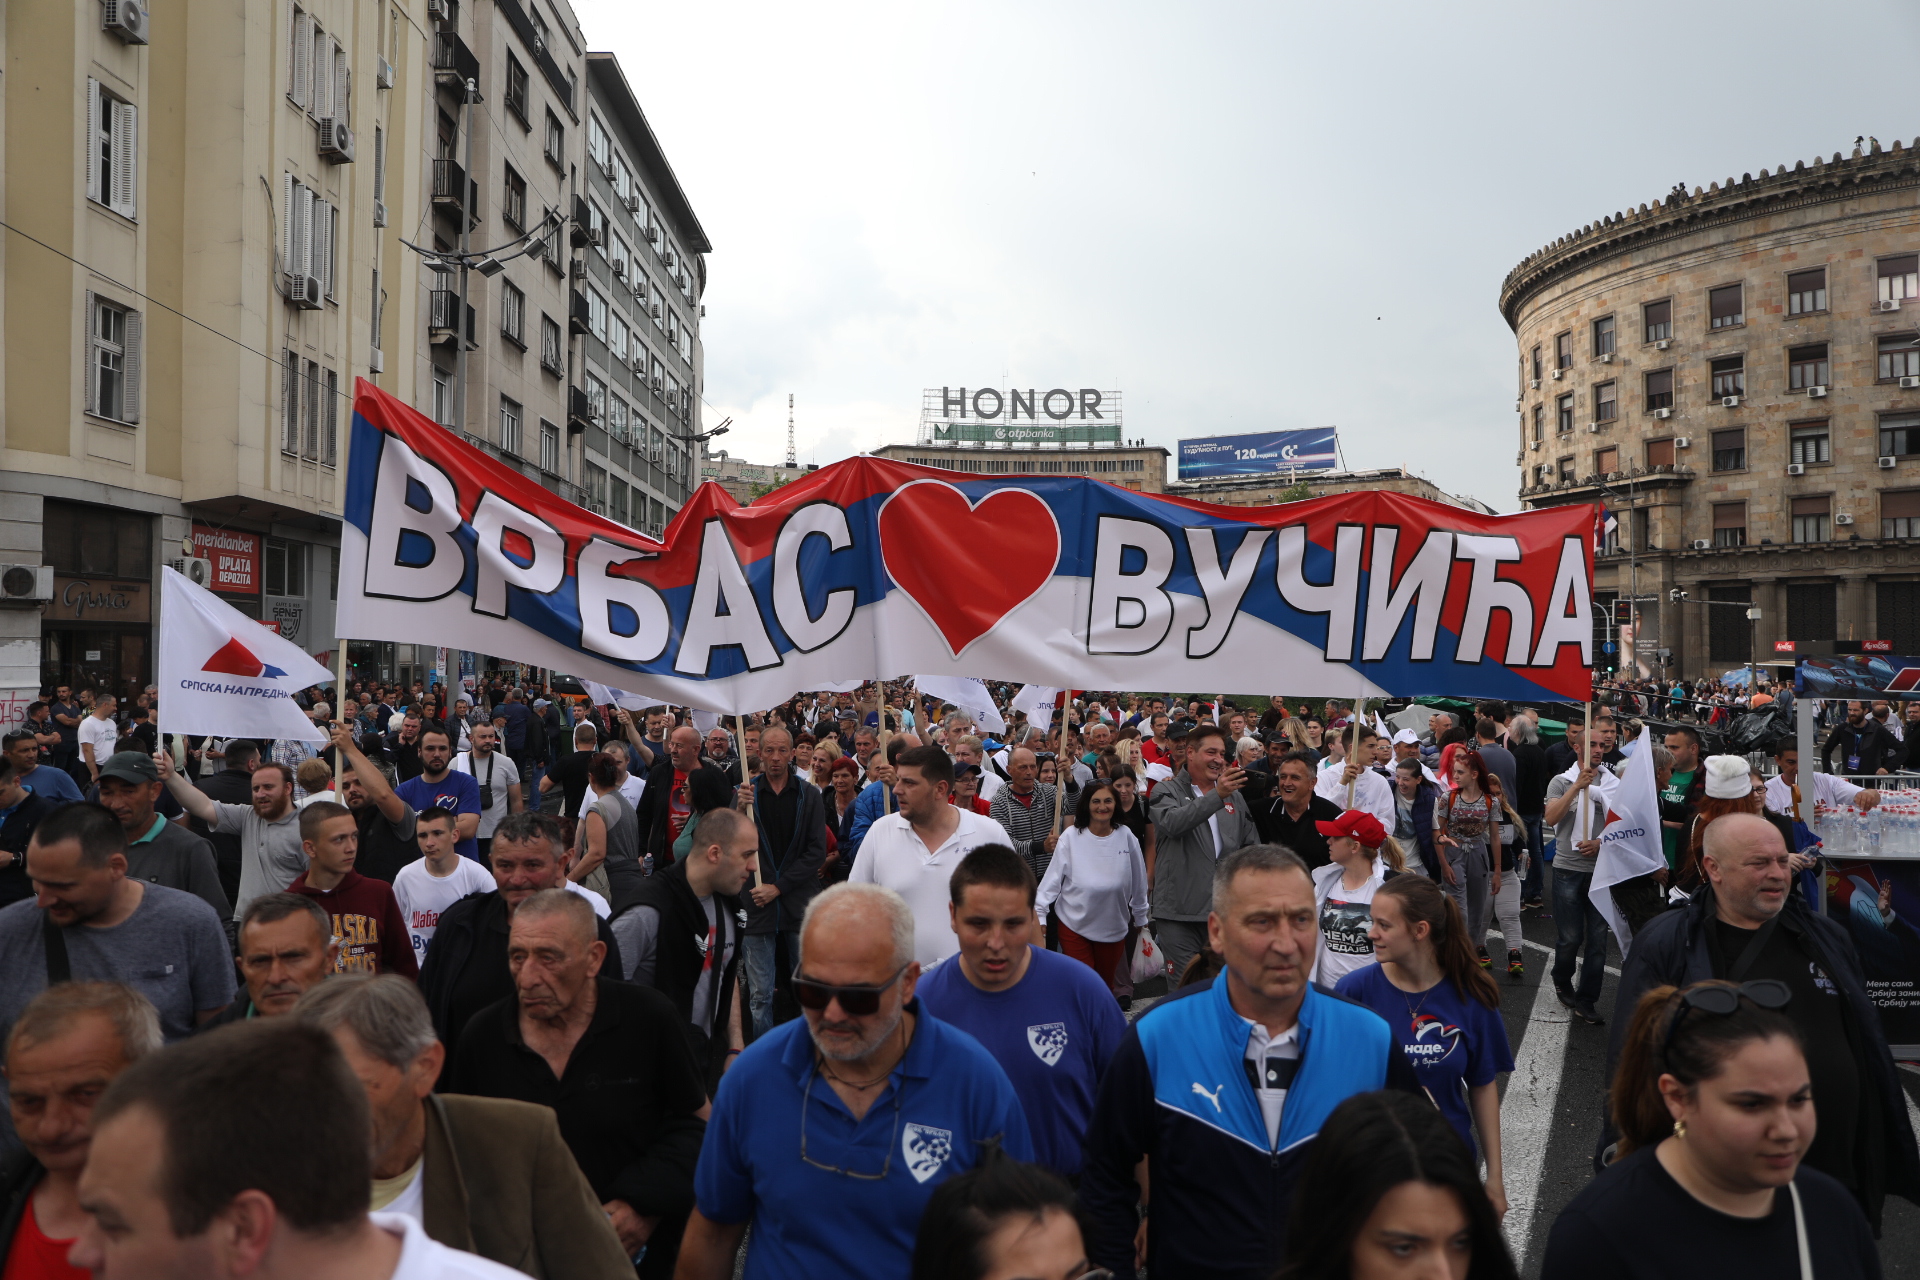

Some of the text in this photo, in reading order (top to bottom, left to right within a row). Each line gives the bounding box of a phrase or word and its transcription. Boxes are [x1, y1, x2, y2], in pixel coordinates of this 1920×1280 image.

[943, 386, 1104, 420] HONOR
[1234, 449, 1257, 460] 120
[194, 532, 254, 553] meridianbet
[363, 429, 1593, 678] ВРБАС ВУЧИЋА
[219, 556, 251, 573] UPLATA
[219, 571, 251, 585] DEPOZITA
[180, 679, 222, 693] СРПСКА
[411, 909, 442, 928] Шаба
[332, 913, 379, 945] ASKA
[351, 946, 365, 954] 1985
[1327, 942, 1370, 953] РЕДАЈЕ!
[1866, 980, 1890, 988] Мене
[1867, 989, 1897, 998] Србија
[1878, 999, 1908, 1008] Србију
[1404, 1043, 1445, 1055] наде.
